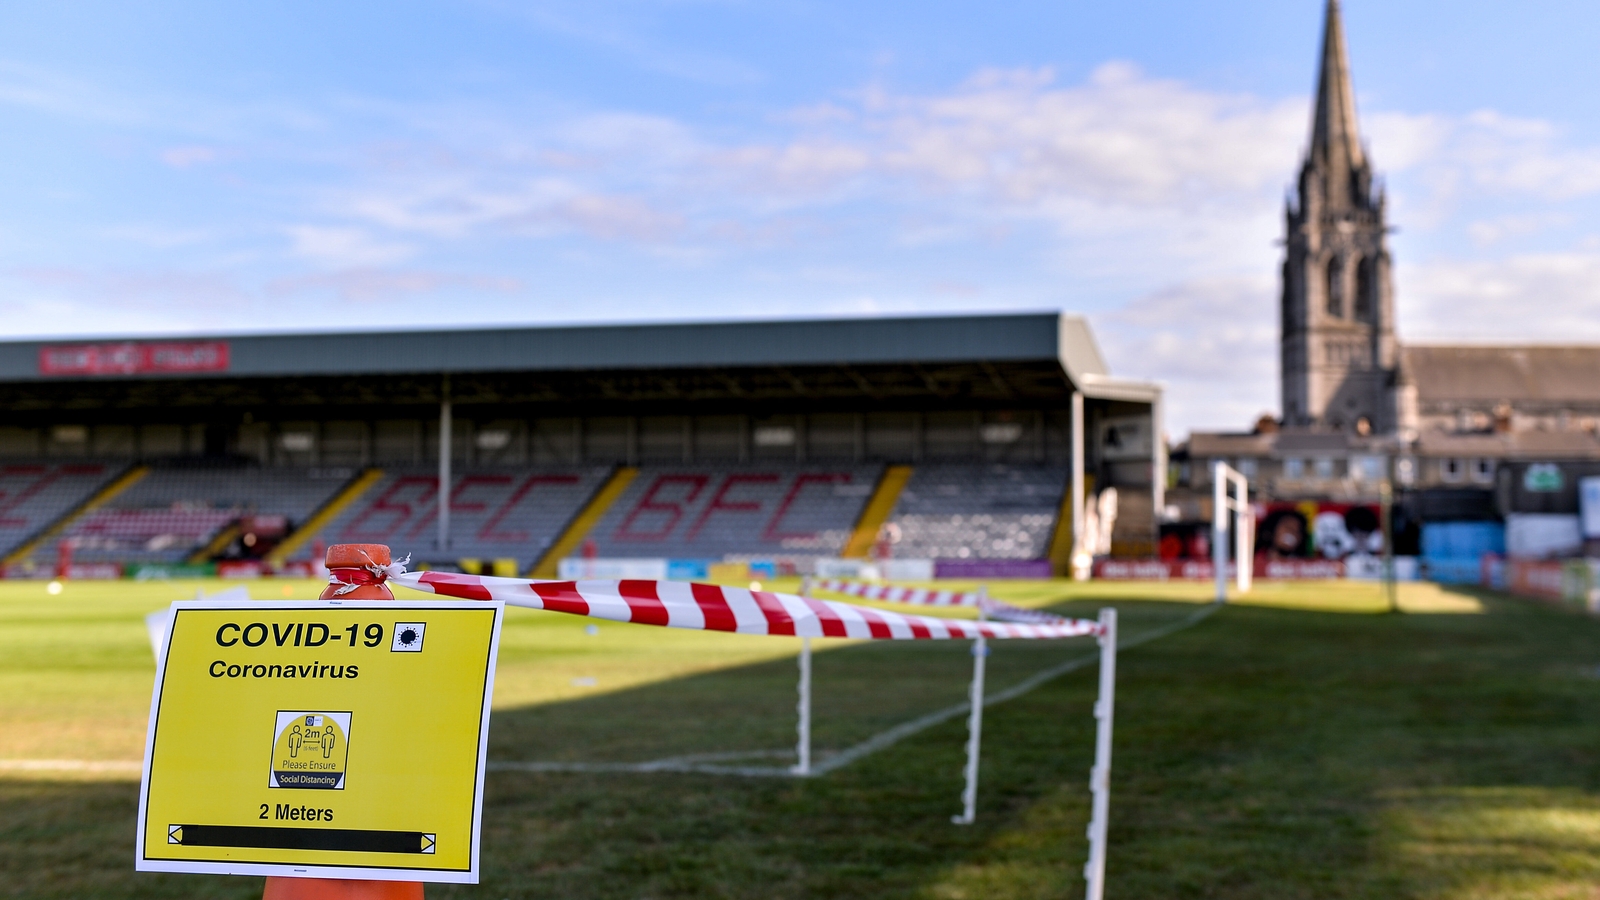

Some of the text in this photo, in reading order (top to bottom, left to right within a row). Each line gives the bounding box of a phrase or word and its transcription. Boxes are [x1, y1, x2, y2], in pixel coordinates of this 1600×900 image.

[338, 475, 580, 541] BFC
[611, 474, 853, 543] BFC
[215, 623, 384, 647] COVID-19
[209, 660, 359, 678] Coronavirus
[304, 729, 320, 738] 2m
[282, 760, 336, 770] Please Ensure
[280, 775, 336, 786] Social Distancing
[259, 803, 334, 821] 2 Meters
